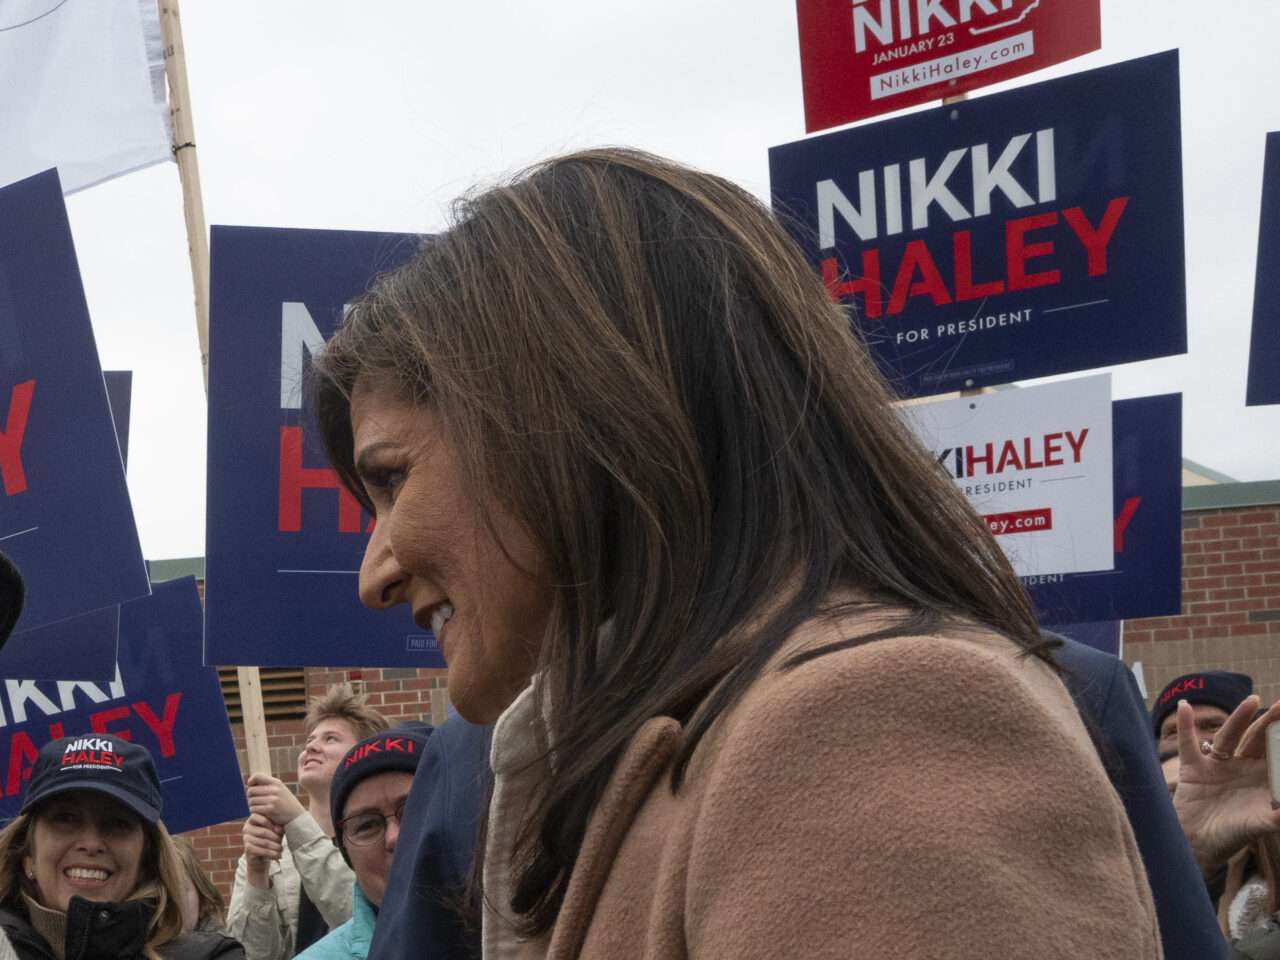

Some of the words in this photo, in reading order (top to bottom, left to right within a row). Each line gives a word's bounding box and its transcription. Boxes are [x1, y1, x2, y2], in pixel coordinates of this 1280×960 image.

[872, 38, 935, 66] JANUARY
[937, 32, 955, 48] 23
[880, 42, 1026, 92] NikkiHaley.com
[816, 127, 1057, 250] NIKKI
[820, 196, 1130, 320] HALEY
[896, 329, 930, 345] FOR
[937, 308, 1033, 337] PRESIDENT
[61, 750, 124, 769] HALEY
[64, 738, 113, 754] NIKKI
[344, 736, 415, 769] NIKKI
